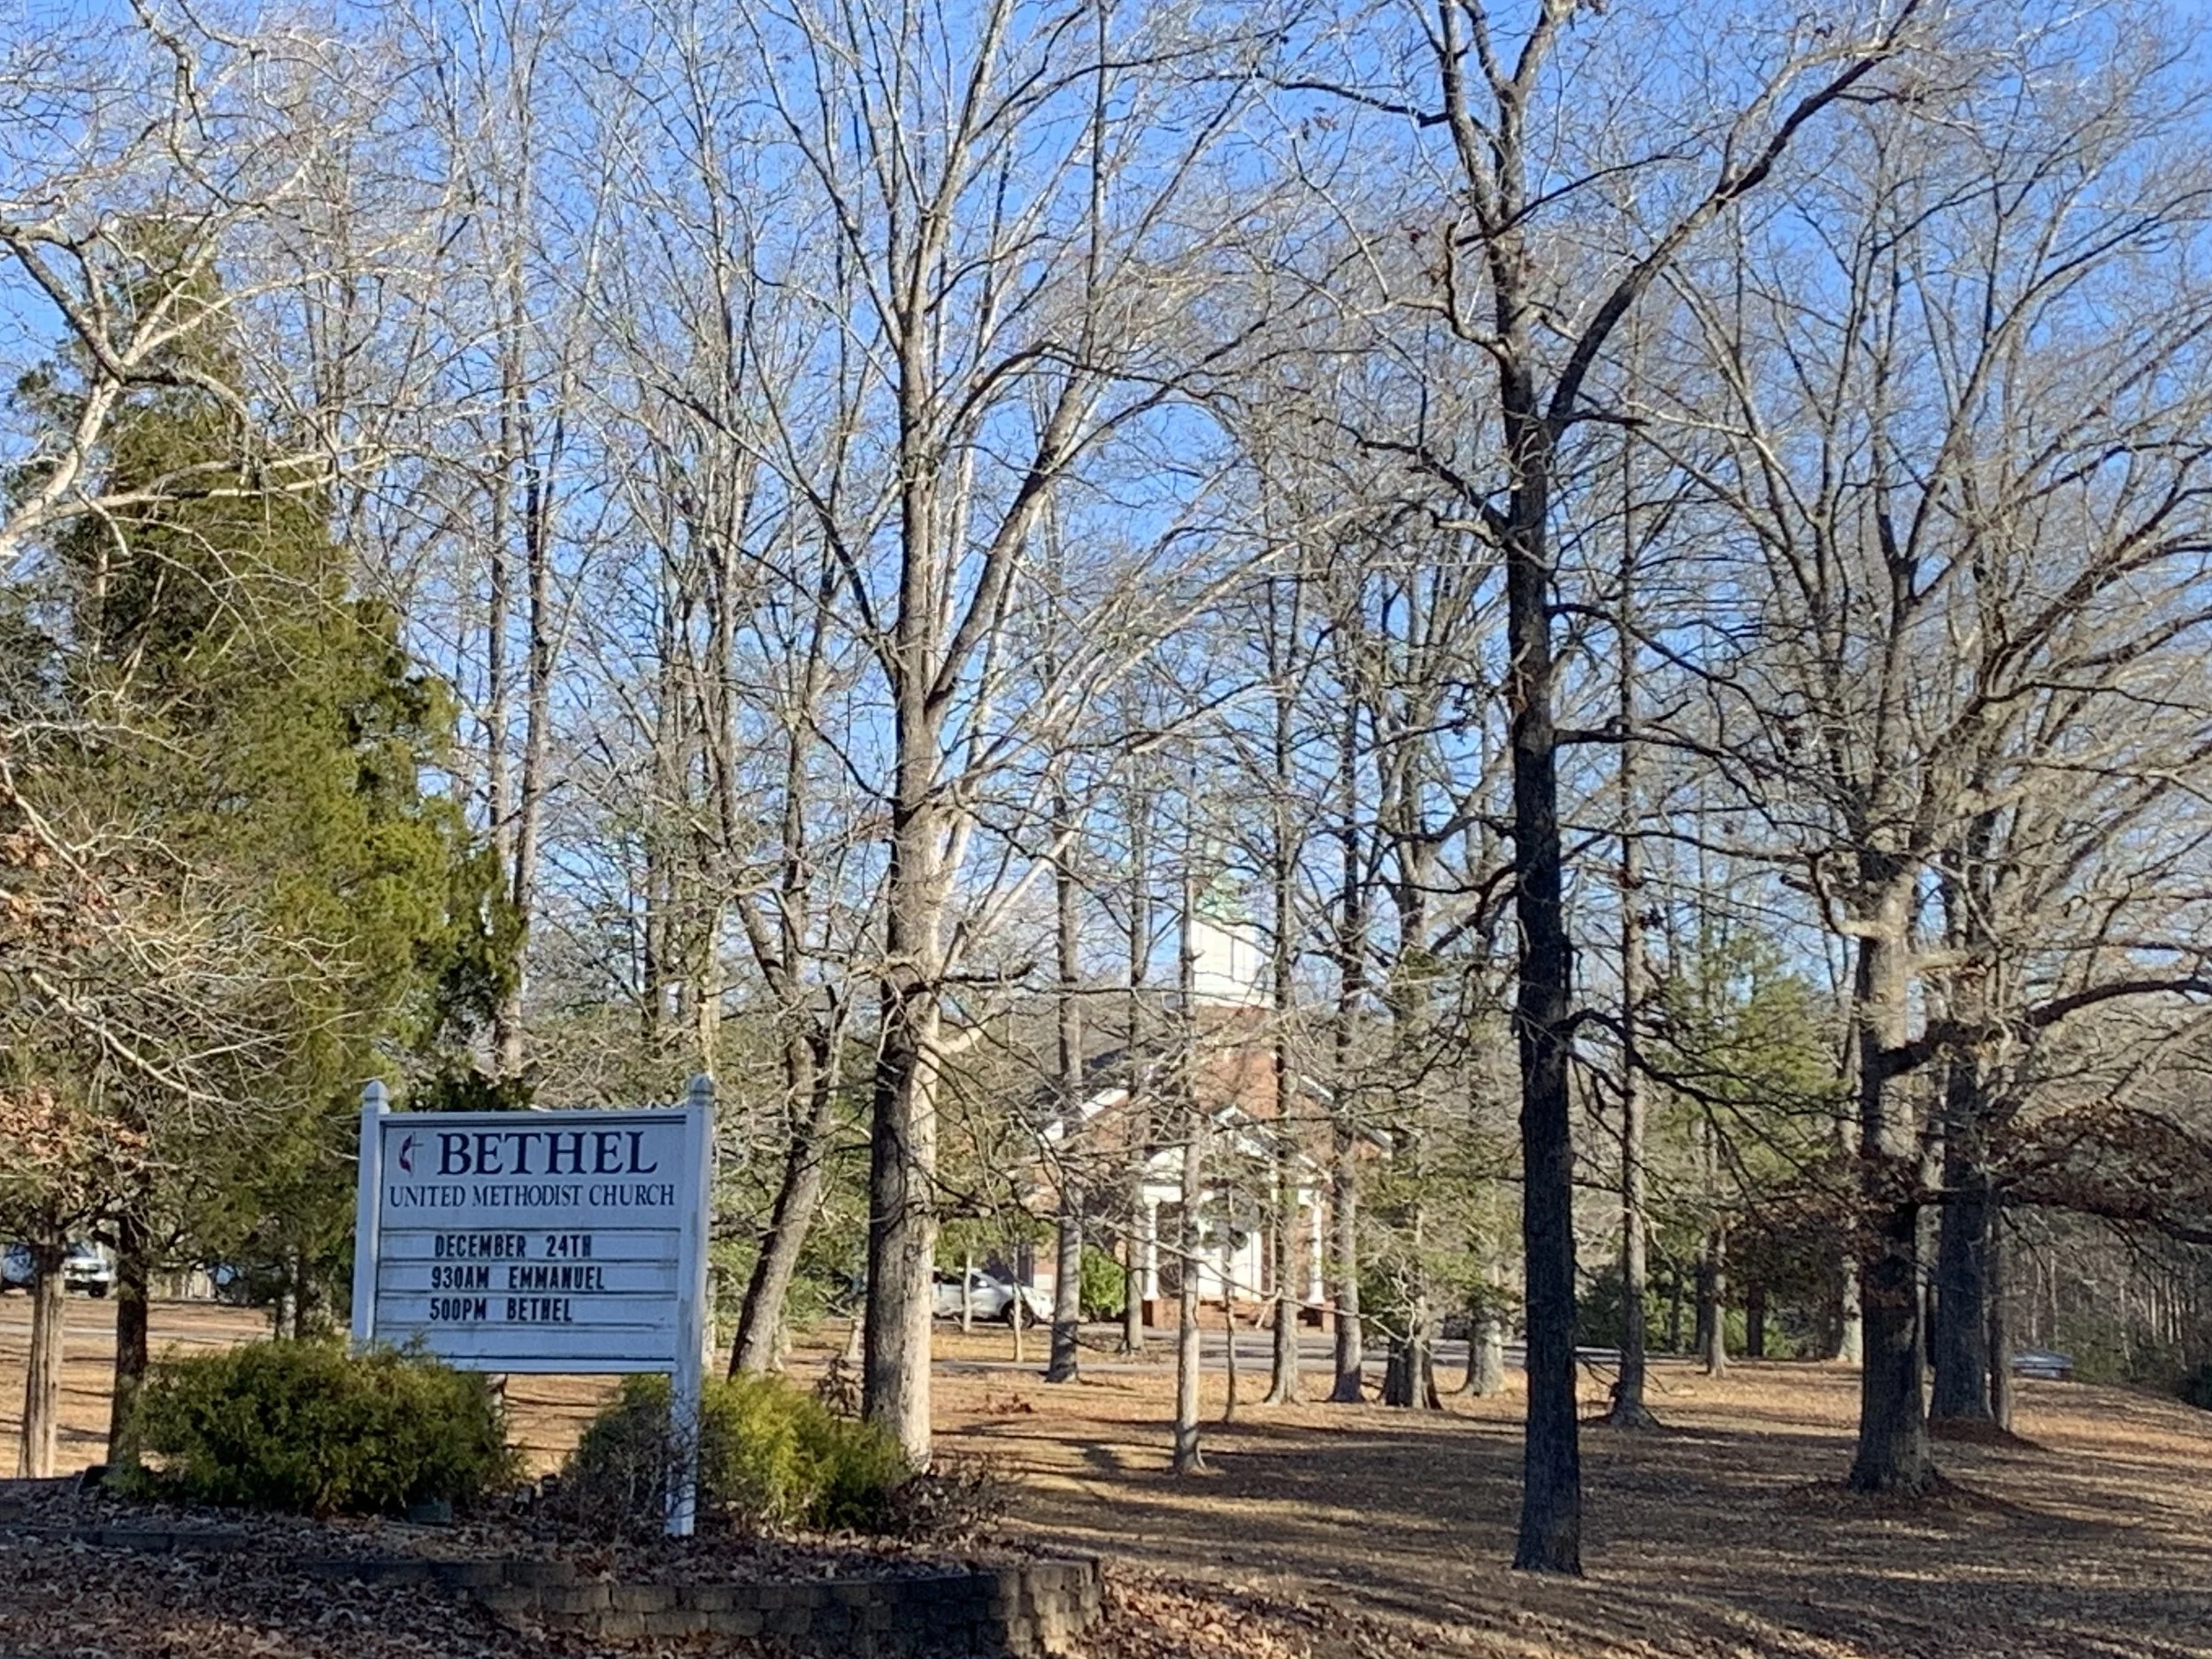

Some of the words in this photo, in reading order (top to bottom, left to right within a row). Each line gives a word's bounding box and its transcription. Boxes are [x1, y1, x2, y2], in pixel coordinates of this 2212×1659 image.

[436, 1131, 658, 1175] BETHEL
[389, 1186, 465, 1207] UNITED
[472, 1184, 583, 1207] METHODIST
[588, 1183, 675, 1206] CHURCH
[434, 1234, 526, 1257] DECEMBER
[546, 1234, 592, 1257] 24TH
[431, 1266, 489, 1289] 930AM
[509, 1266, 605, 1290] EMMANUEL
[429, 1297, 487, 1321] 500PM
[506, 1298, 572, 1322] BETHEL
